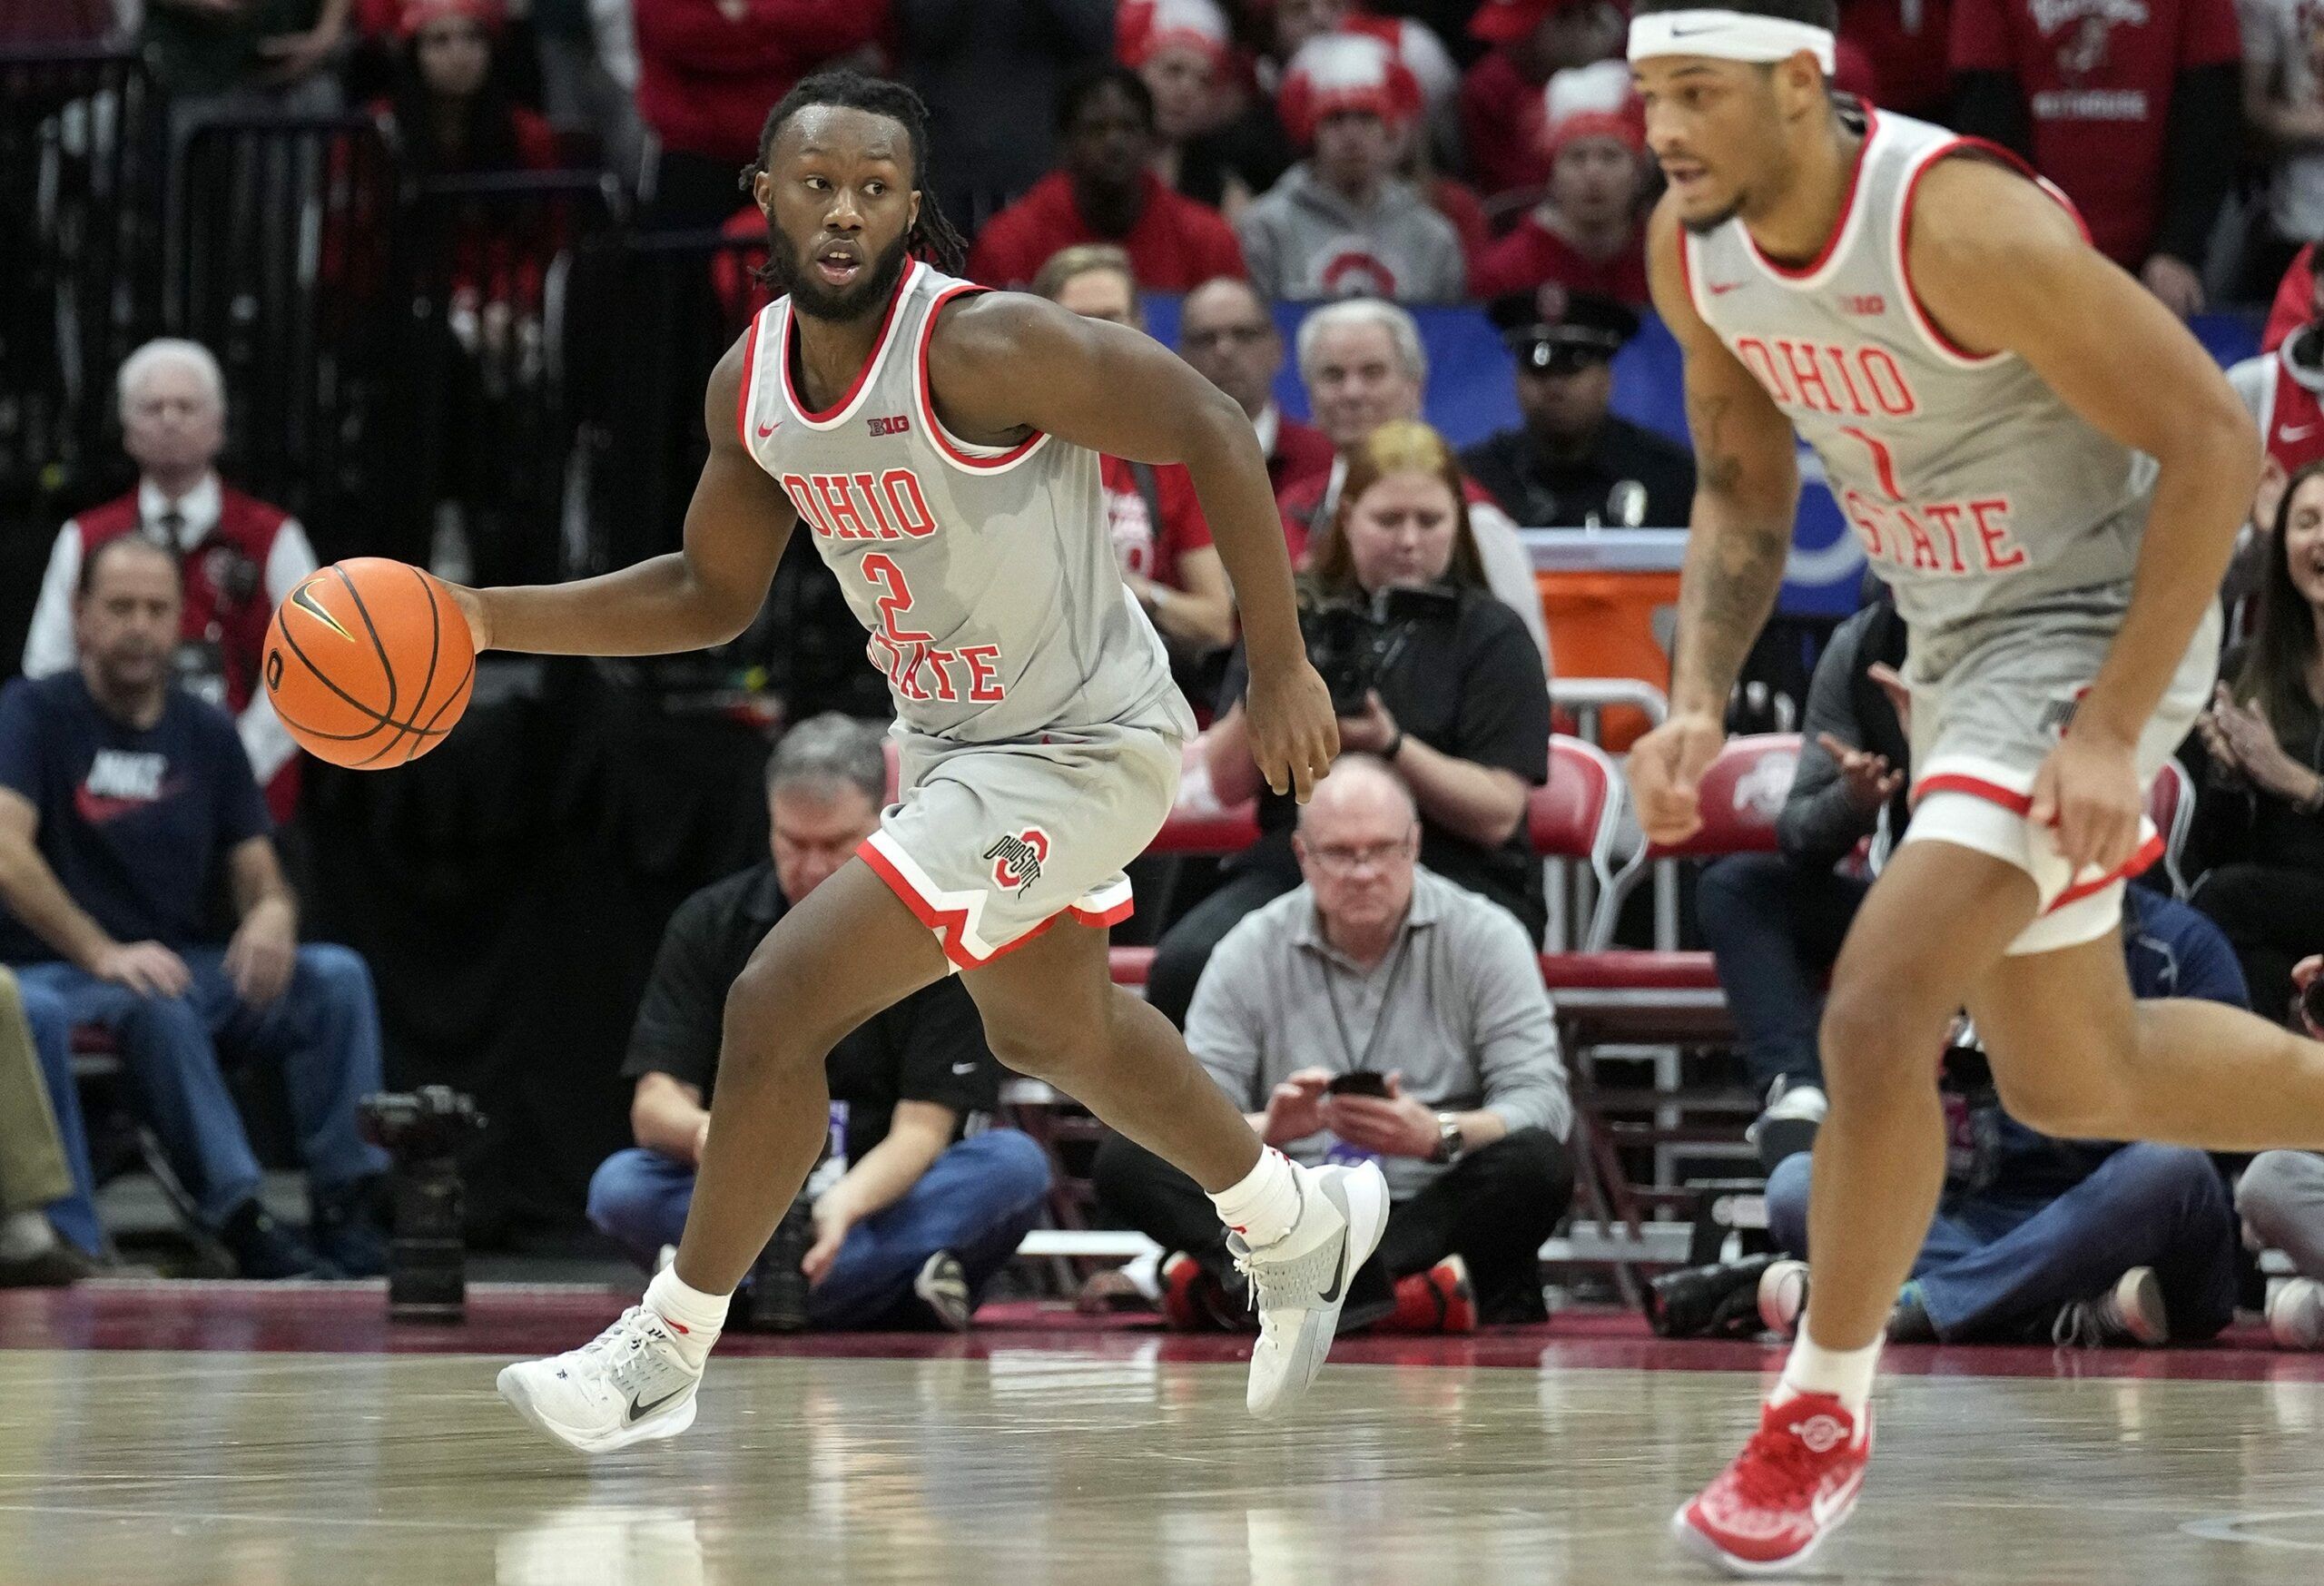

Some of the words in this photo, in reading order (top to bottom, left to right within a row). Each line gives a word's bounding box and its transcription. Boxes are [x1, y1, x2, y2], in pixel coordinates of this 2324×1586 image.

[1841, 424, 1906, 502] 1
[782, 467, 939, 541] OHIO
[860, 552, 937, 644] 2
[866, 625, 1006, 704] TATE
